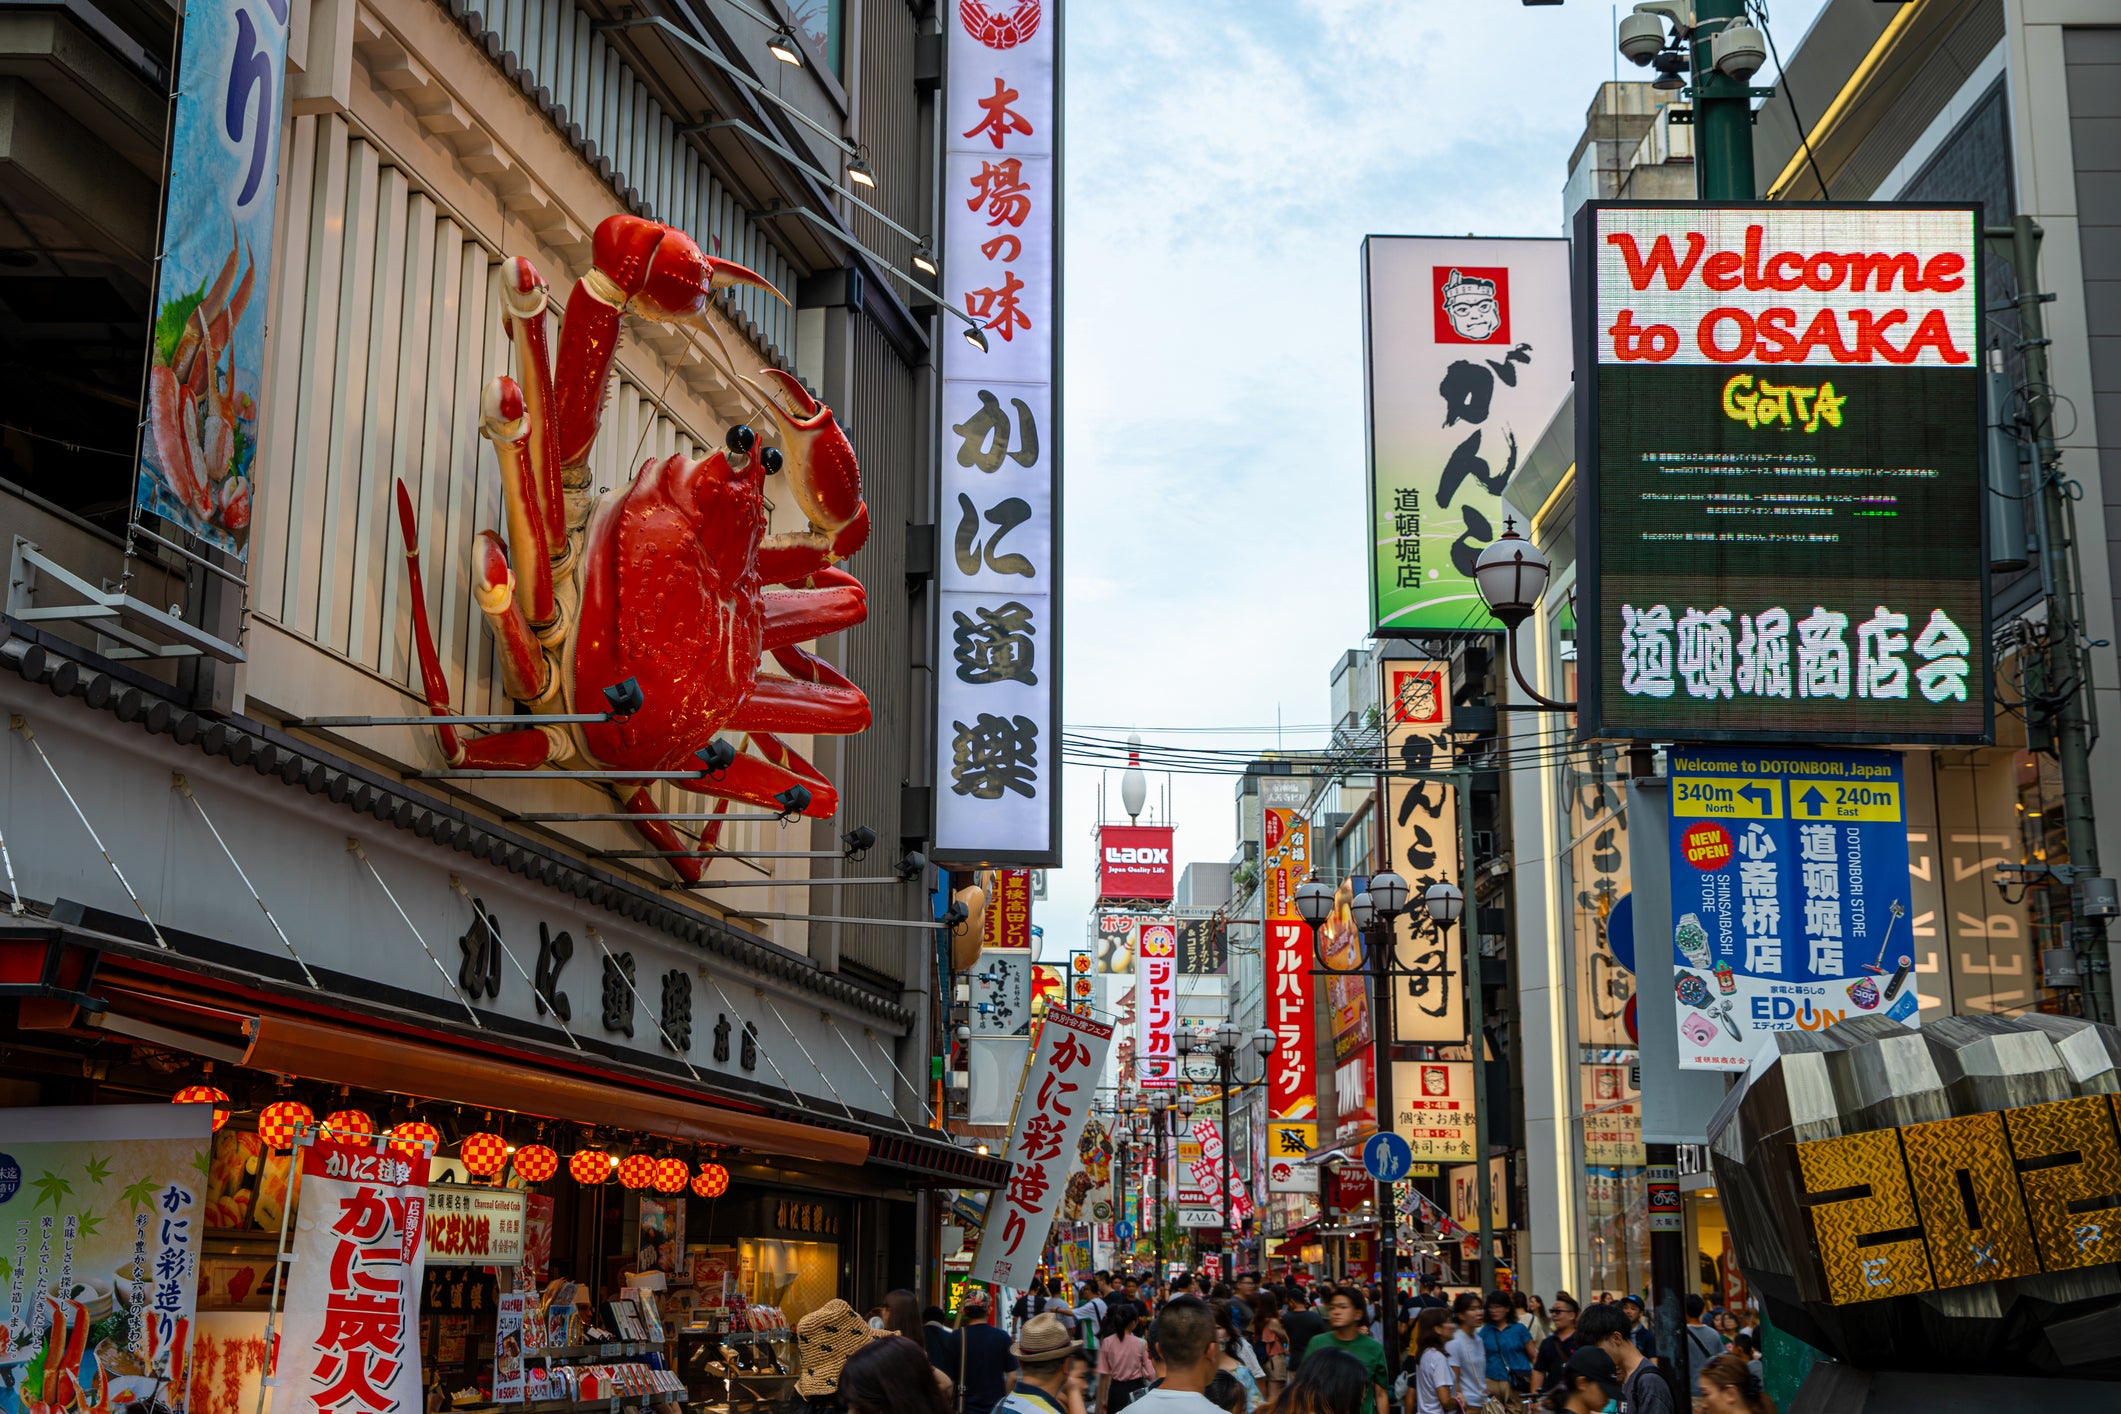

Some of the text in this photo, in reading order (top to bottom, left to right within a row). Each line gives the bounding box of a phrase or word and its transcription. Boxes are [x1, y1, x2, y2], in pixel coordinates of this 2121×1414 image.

[226, 0, 288, 206] り
[962, 77, 1034, 342] 本場の味
[1607, 224, 1965, 293] Welcome
[1608, 307, 1970, 363] to OSAKA
[1436, 343, 1533, 578] がんこ
[1394, 488, 1422, 589] 道頓堀店
[1621, 604, 1970, 703] 道頓堀商店会
[1674, 758, 1738, 773] Welcome
[1741, 759, 1757, 773] to
[1677, 783, 1733, 802] 340m
[1835, 788, 1892, 805] 240m
[1689, 830, 1721, 847] NEW
[1705, 804, 1735, 813] North
[1837, 808, 1859, 816] East
[1108, 866, 1165, 874] Japan Quality Life
[1688, 844, 1730, 862] OPEN!
[1846, 827, 1866, 938] DOTONBORI STORE
[1005, 877, 1028, 947] 豊後高田どり
[1701, 874, 1716, 913] STORE
[1717, 874, 1734, 955] SHINSAIBASHI
[1739, 823, 1782, 974] 心斋桥店
[1799, 824, 1844, 976] 道顿堀店
[1049, 1010, 1112, 1037] 特別会席フェア
[1149, 961, 1170, 1080] ジャンカラ
[1275, 926, 1306, 1095] ツルハドラッグ
[1770, 985, 1825, 995] 家電と暮らしの
[1752, 1021, 1794, 1031] エディオン
[1002, 1032, 1091, 1257] かに彩造り
[1400, 1112, 1476, 1126] 個室・お座敷
[325, 1151, 412, 1185] かに道楽
[428, 1193, 470, 1210] 道頓堀名物
[474, 1199, 521, 1210] Charcoal Grilled Crab
[1187, 1211, 1217, 1222] ZAZA
[7, 1219, 30, 1359] 一つ一つ丁寧に造りました。
[32, 1216, 53, 1350] 楽しんでいただきたいと
[59, 1215, 77, 1319] 美味しさを探求し、
[128, 1214, 149, 1353] 彩り豊かな六種の味わい
[155, 1186, 192, 1346] かに彩造り
[309, 1186, 404, 1414] かに炭火
